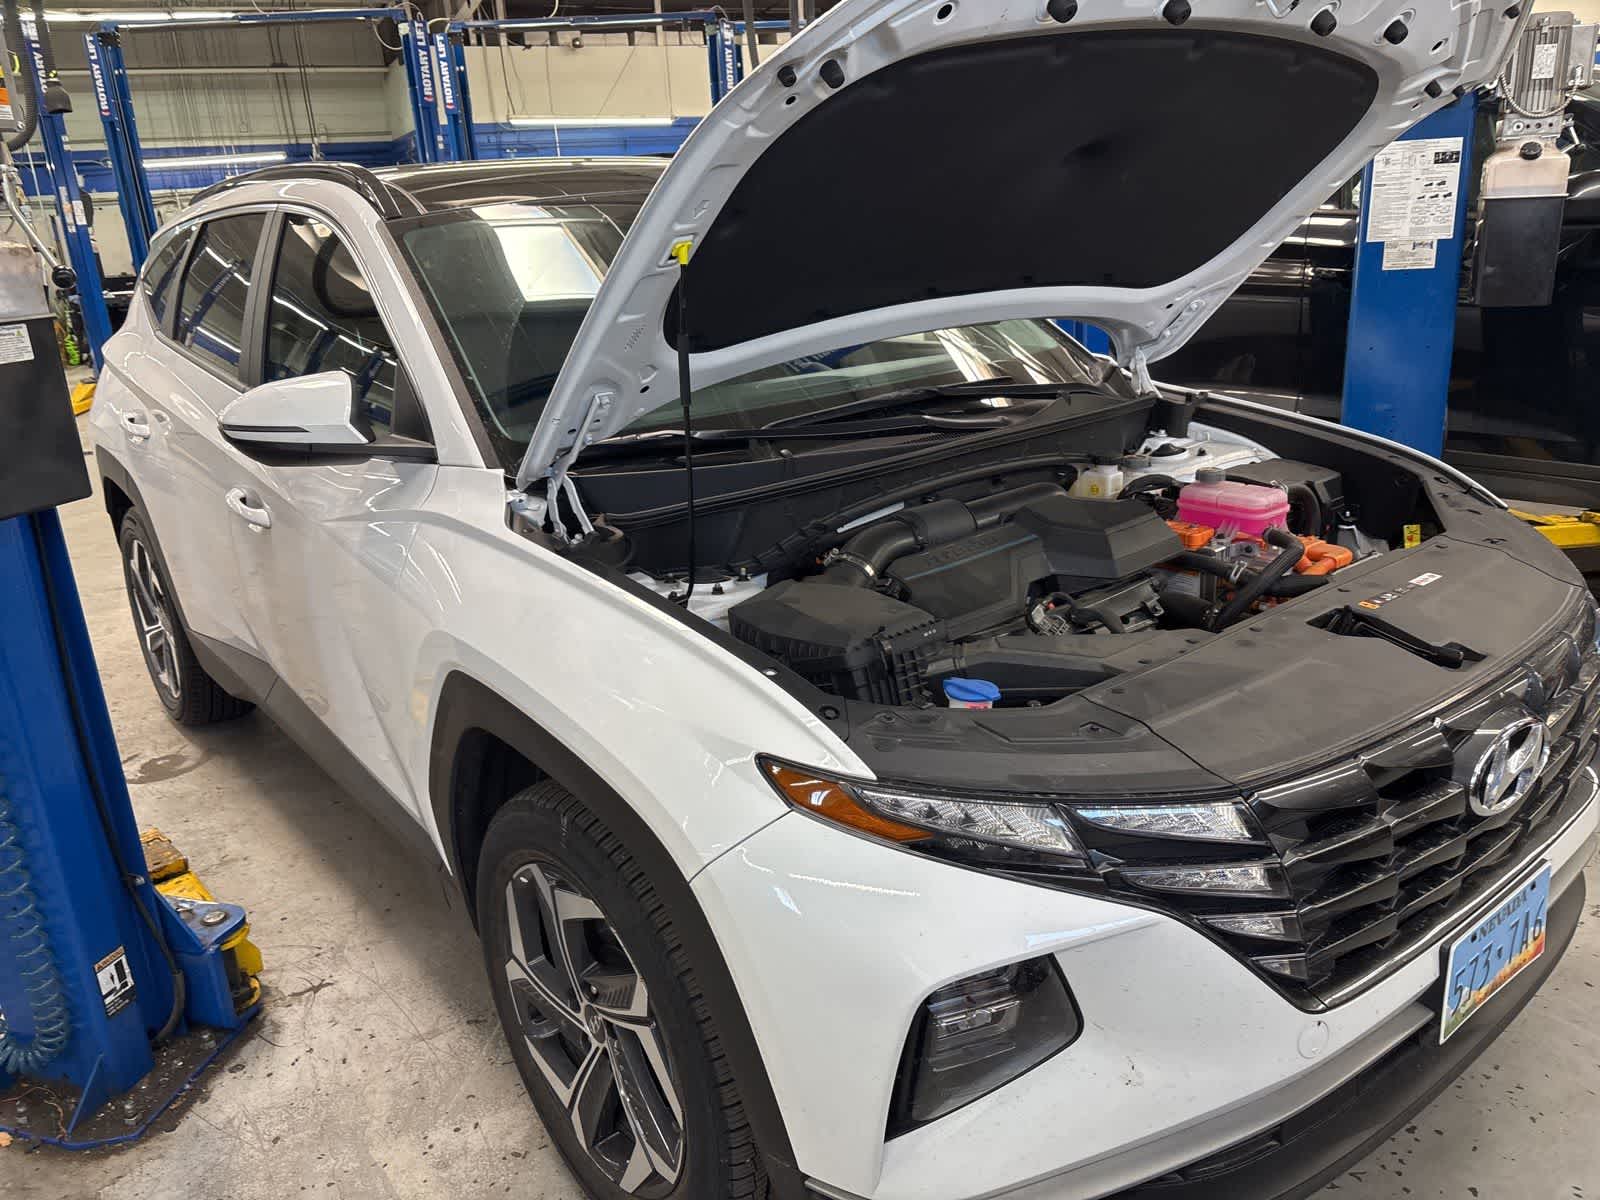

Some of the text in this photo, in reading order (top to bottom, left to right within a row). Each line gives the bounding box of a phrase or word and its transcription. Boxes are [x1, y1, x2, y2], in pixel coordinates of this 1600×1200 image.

[84, 33, 109, 110] ROTARY LIFT
[414, 21, 433, 96] ROTARY LIFT
[436, 33, 453, 104] ROTARY LIFT
[724, 47, 734, 90] ROTARY
[1477, 889, 1528, 942] NEVADA
